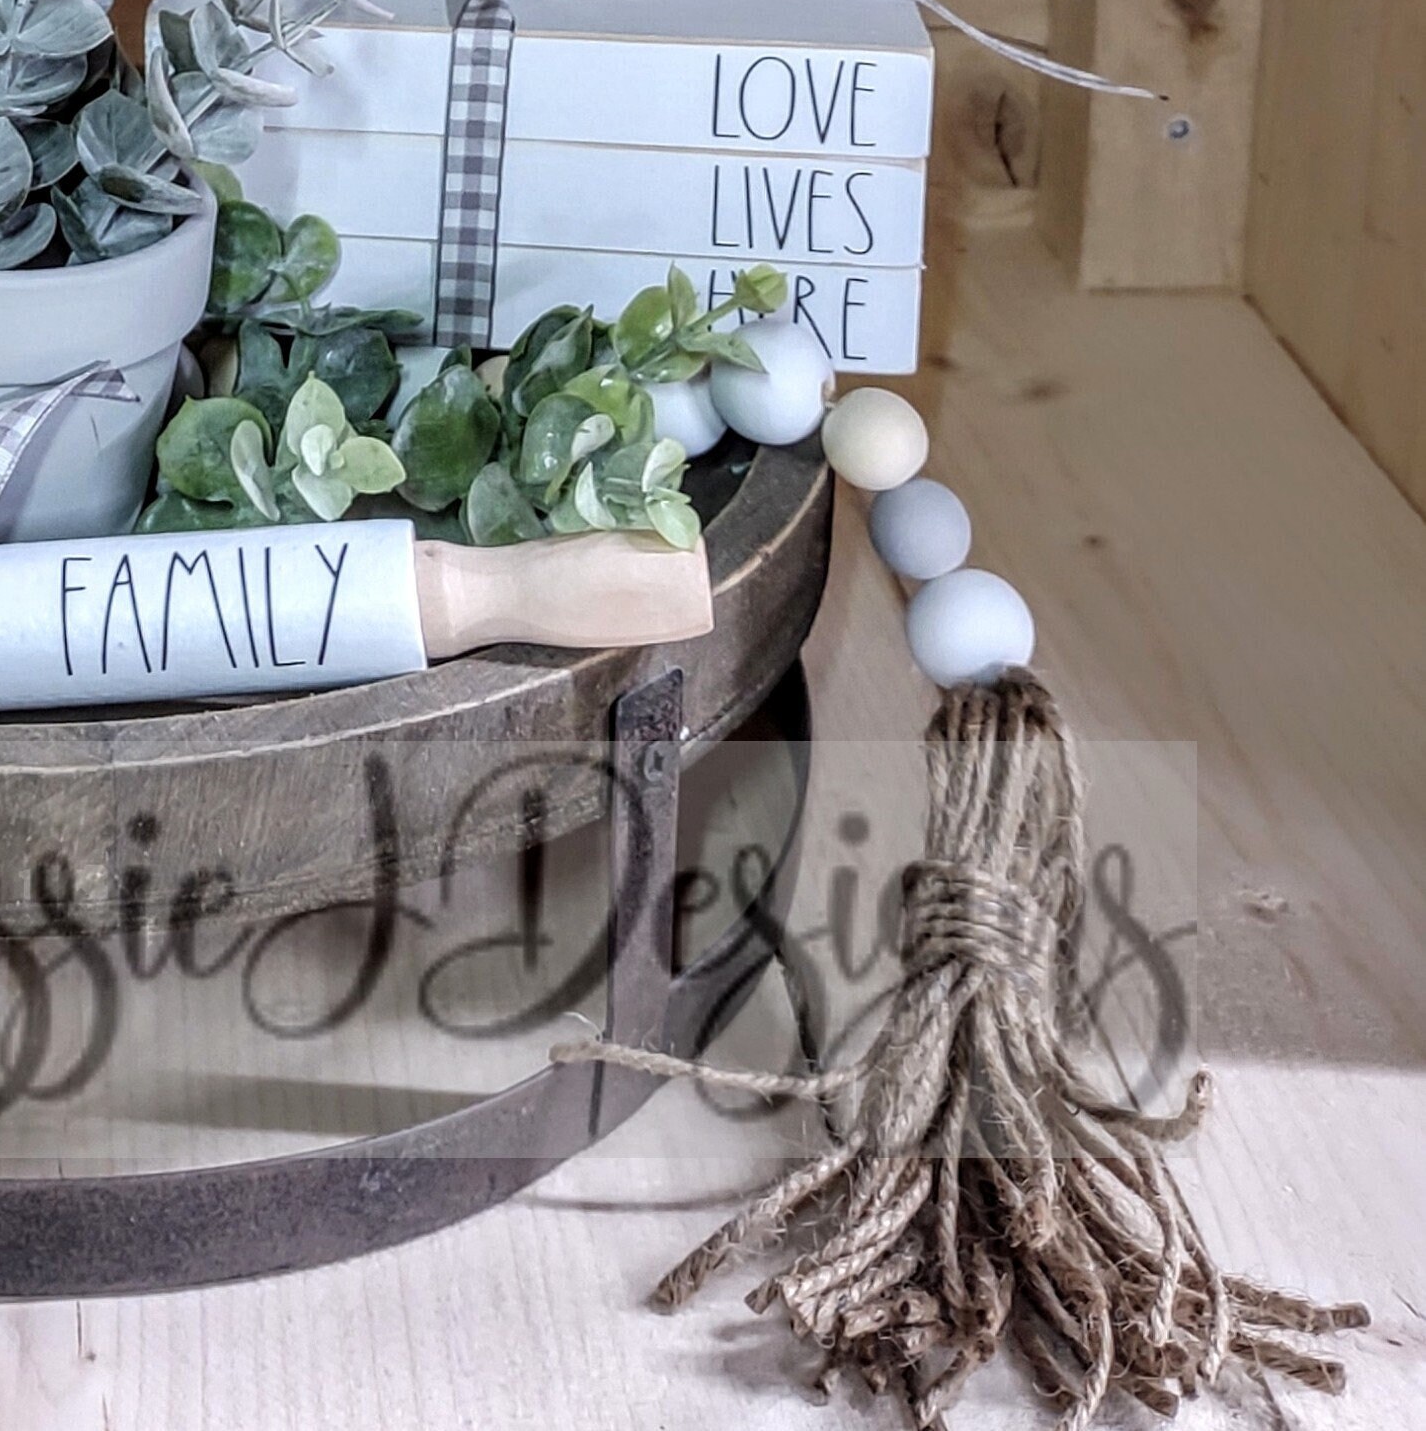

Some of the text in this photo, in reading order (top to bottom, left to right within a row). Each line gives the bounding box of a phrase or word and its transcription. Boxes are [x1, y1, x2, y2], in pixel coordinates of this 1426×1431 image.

[712, 53, 878, 147] LOVE
[712, 164, 874, 256] LIVES
[706, 269, 869, 361] HRE
[60, 542, 349, 676] FAMILY
